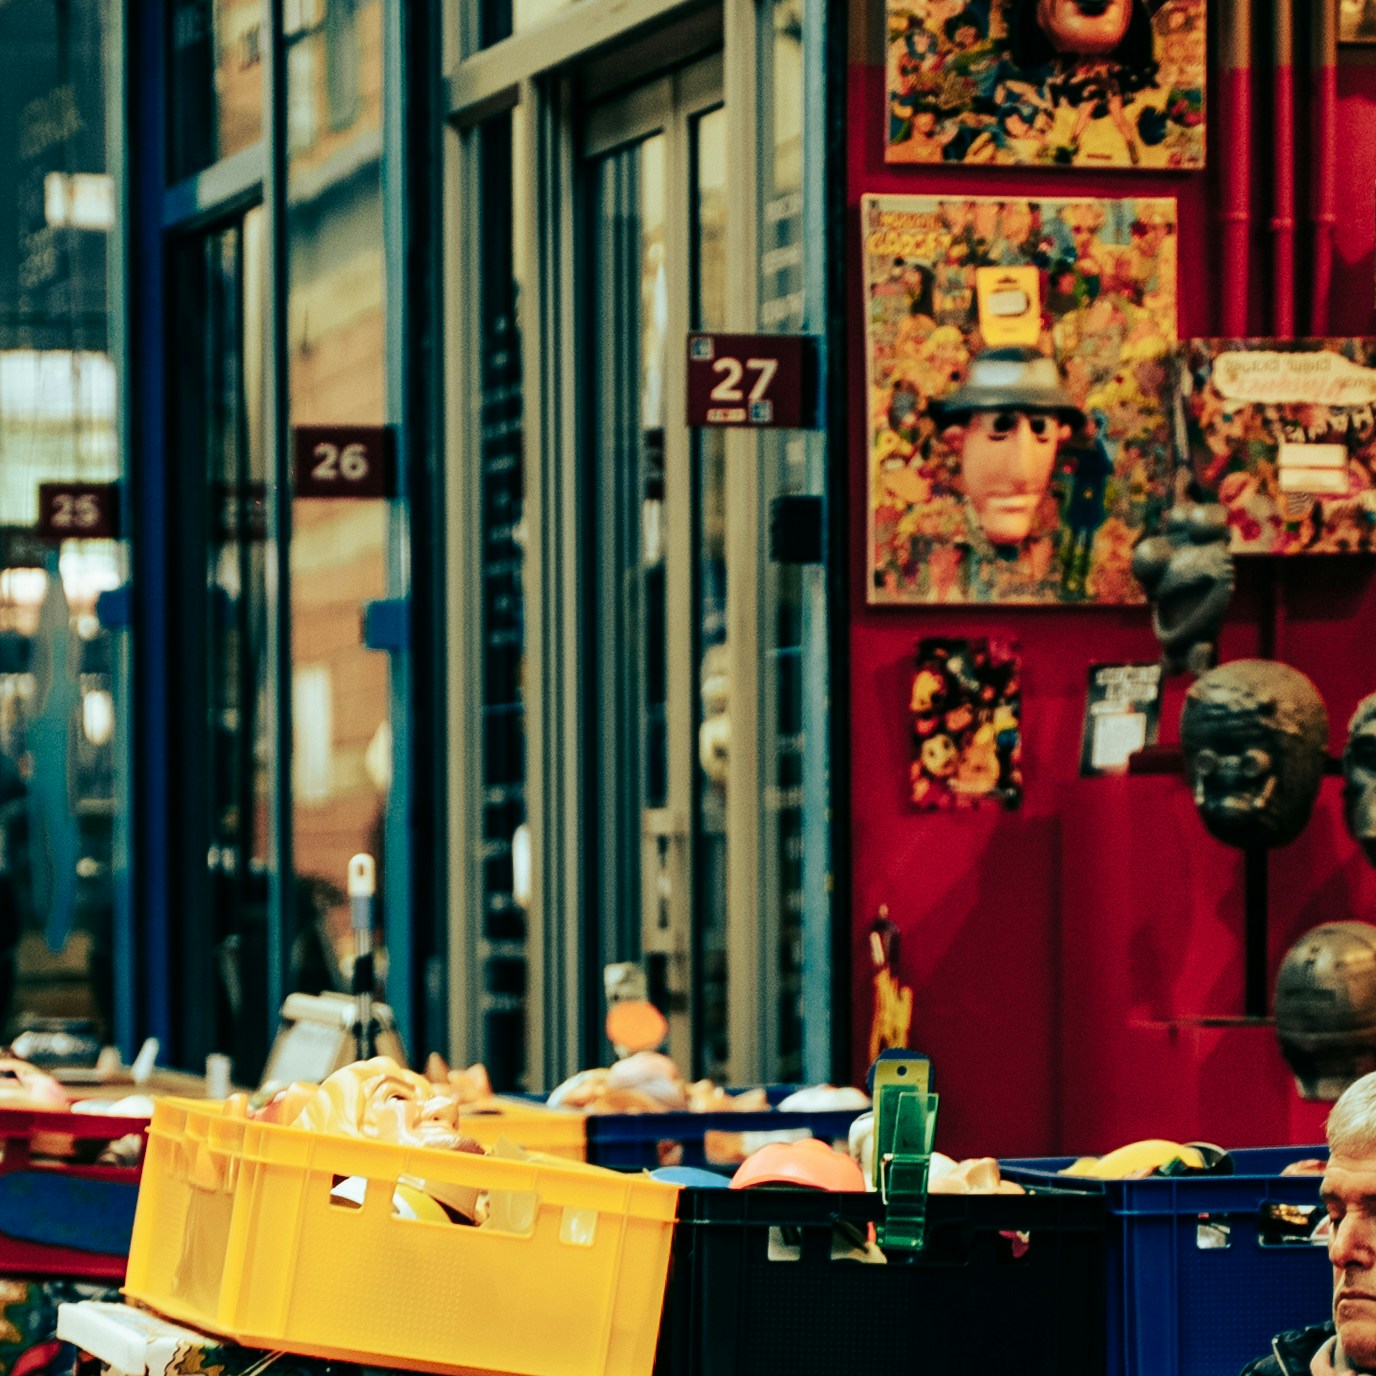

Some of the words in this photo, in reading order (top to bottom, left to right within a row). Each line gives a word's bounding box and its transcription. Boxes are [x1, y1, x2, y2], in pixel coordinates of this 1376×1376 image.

[710, 356, 779, 402] 27
[311, 443, 369, 480] 26
[49, 492, 102, 530] 25
